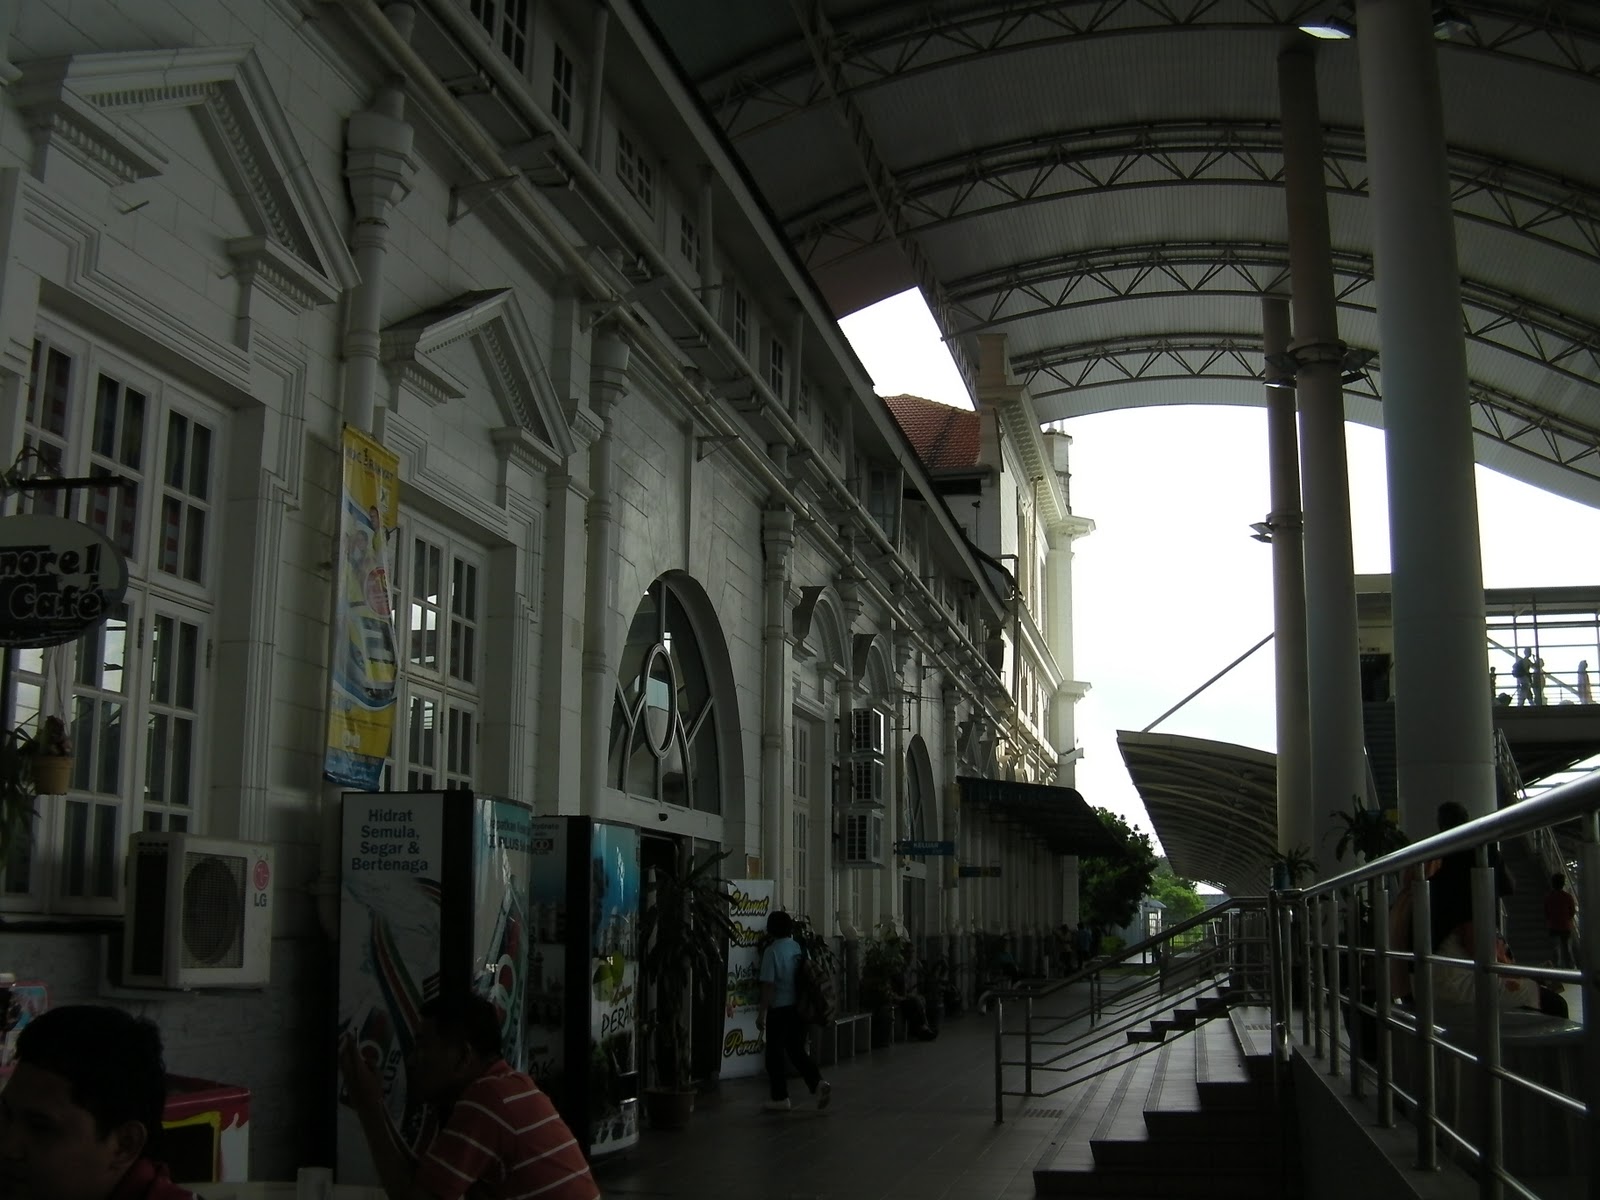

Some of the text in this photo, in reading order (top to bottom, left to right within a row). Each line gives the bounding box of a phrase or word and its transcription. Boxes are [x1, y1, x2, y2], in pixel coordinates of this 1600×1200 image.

[9, 583, 102, 620] Café
[368, 809, 413, 822] Hidrat
[361, 825, 420, 840] Semula,
[360, 841, 420, 857] Segar &
[352, 857, 429, 874] Bertenaga
[254, 893, 267, 907] LG
[723, 1028, 767, 1057] Perak
